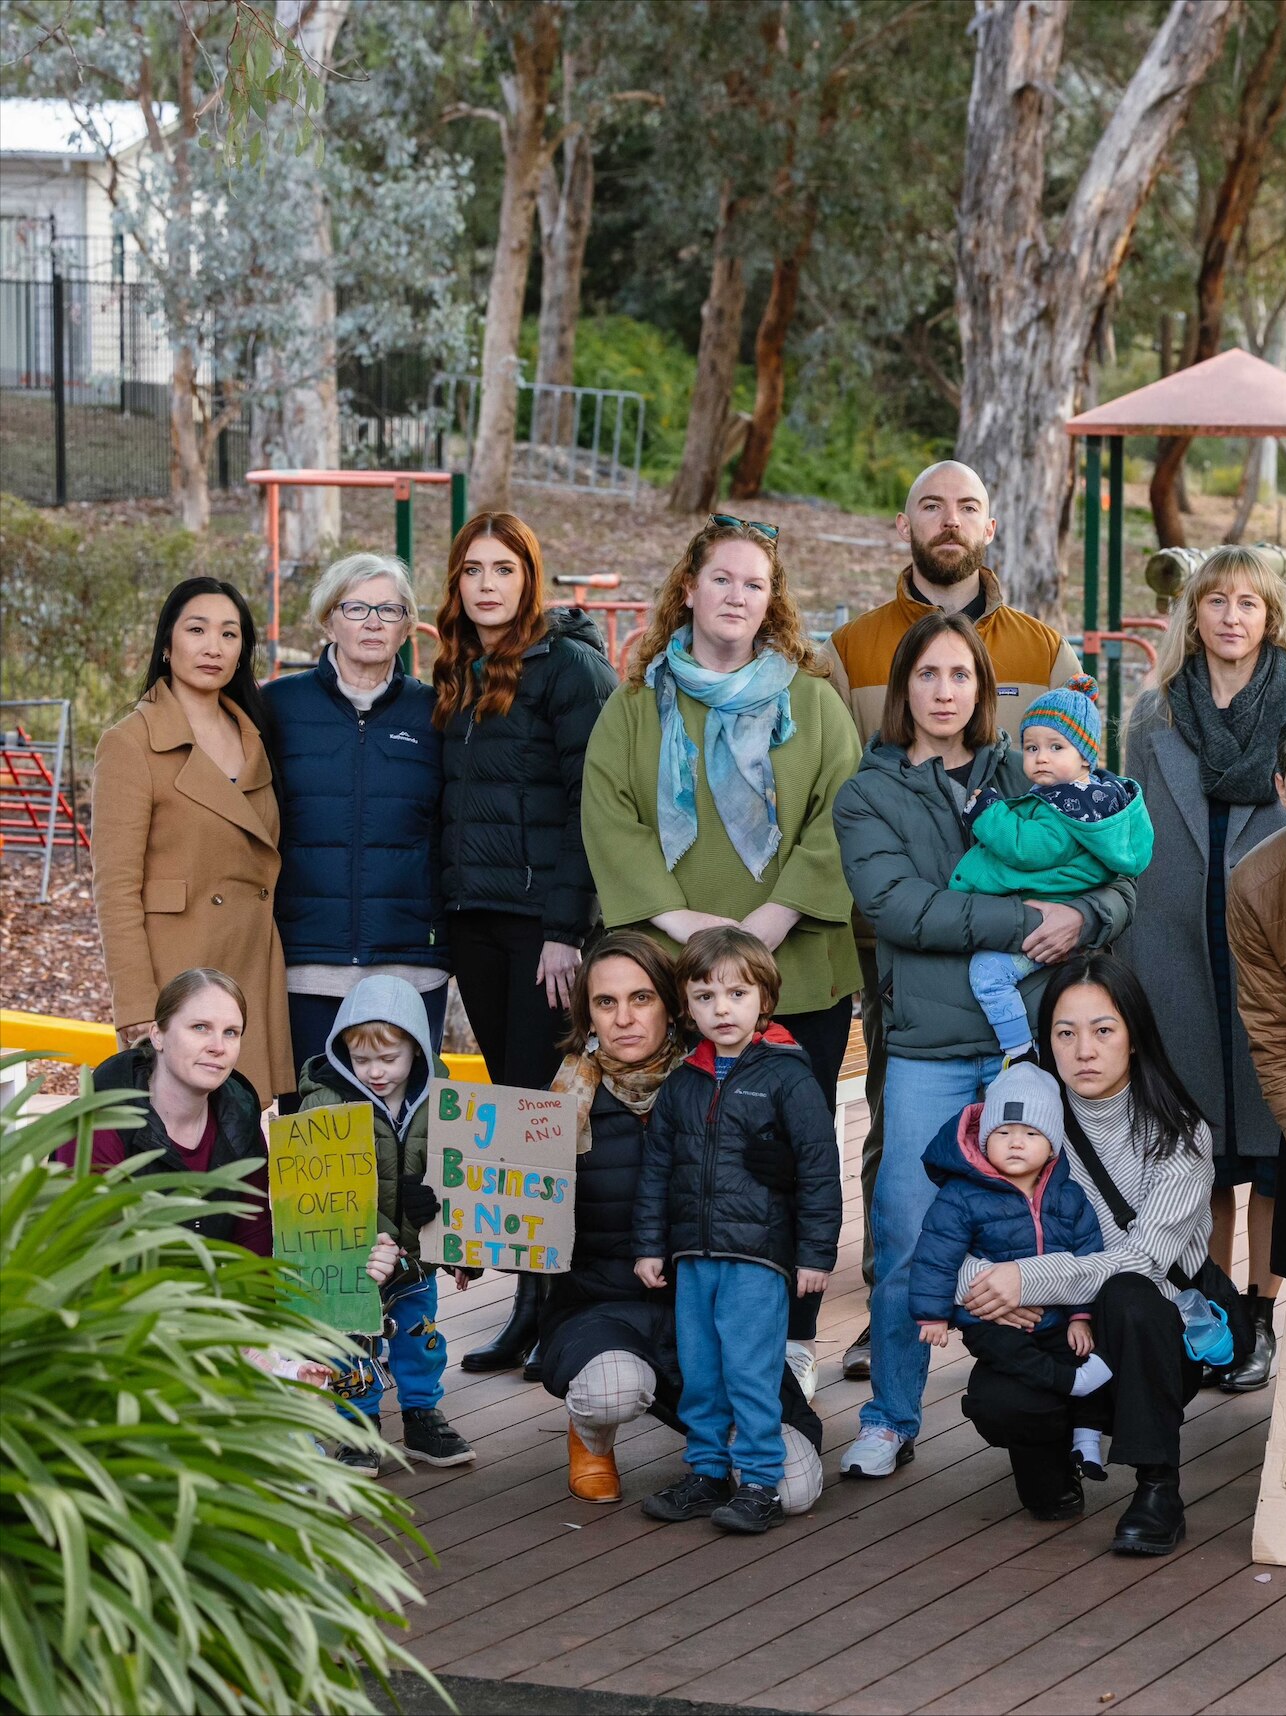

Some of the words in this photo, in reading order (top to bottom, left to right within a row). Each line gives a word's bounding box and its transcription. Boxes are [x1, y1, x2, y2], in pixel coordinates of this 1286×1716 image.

[439, 1088, 497, 1149] Big
[517, 1098, 562, 1111] Shame
[287, 1111, 351, 1148] ANU
[530, 1116, 549, 1125] on
[276, 1151, 373, 1185] PROFITS
[297, 1190, 360, 1216] OVER
[281, 1226, 368, 1253] LITTLE
[443, 1233, 561, 1269] BETTER
